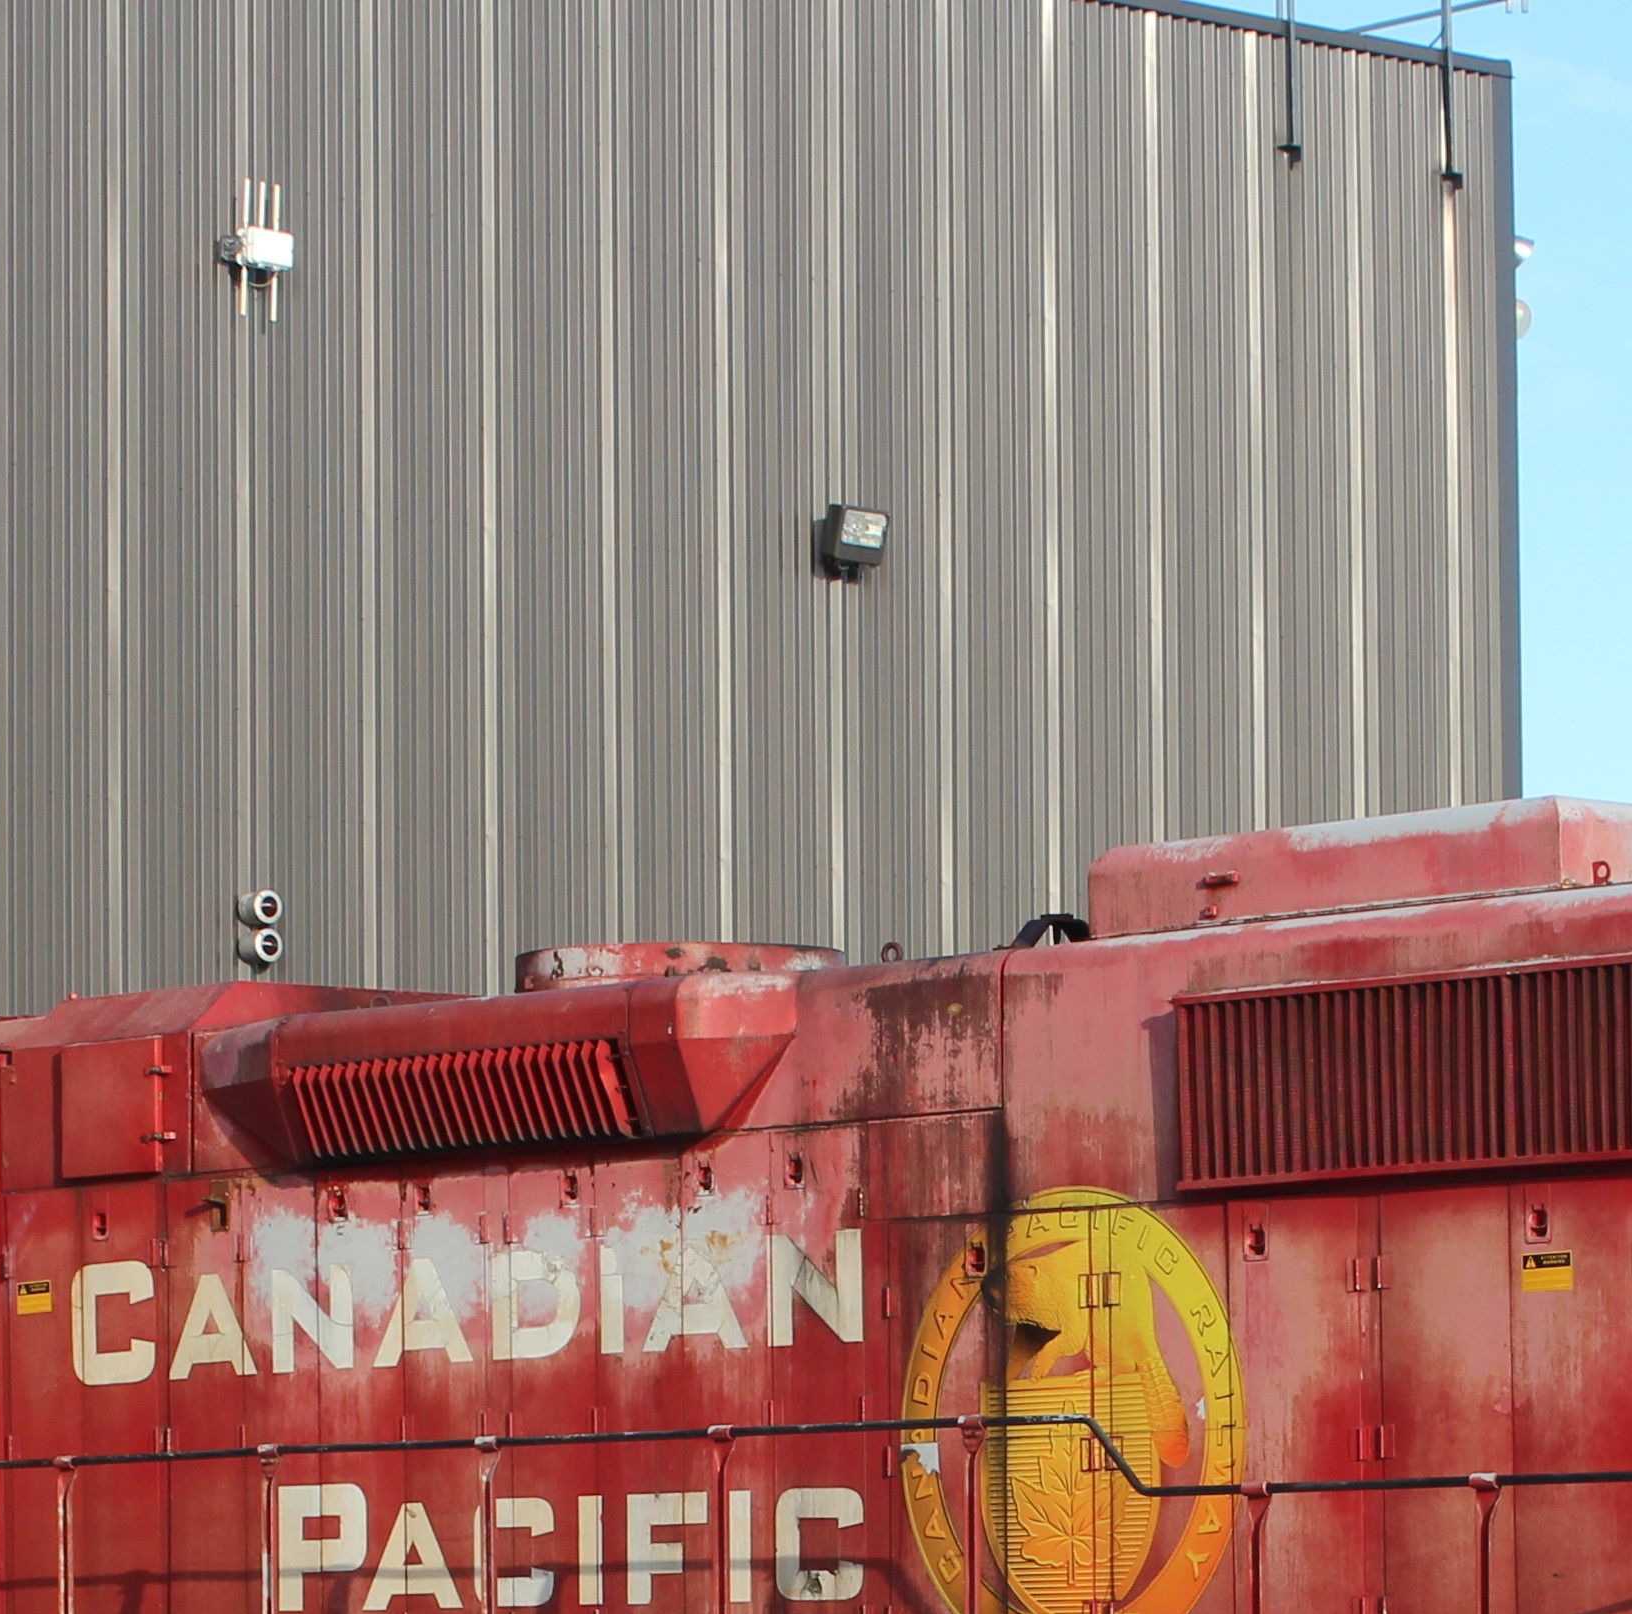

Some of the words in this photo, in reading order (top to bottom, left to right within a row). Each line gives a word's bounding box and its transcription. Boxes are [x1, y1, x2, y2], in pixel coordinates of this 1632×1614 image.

[1006, 1201, 1179, 1275] ACIFIC
[71, 1228, 864, 1386] CANADIAN
[278, 1483, 865, 1613] PACIFIC
